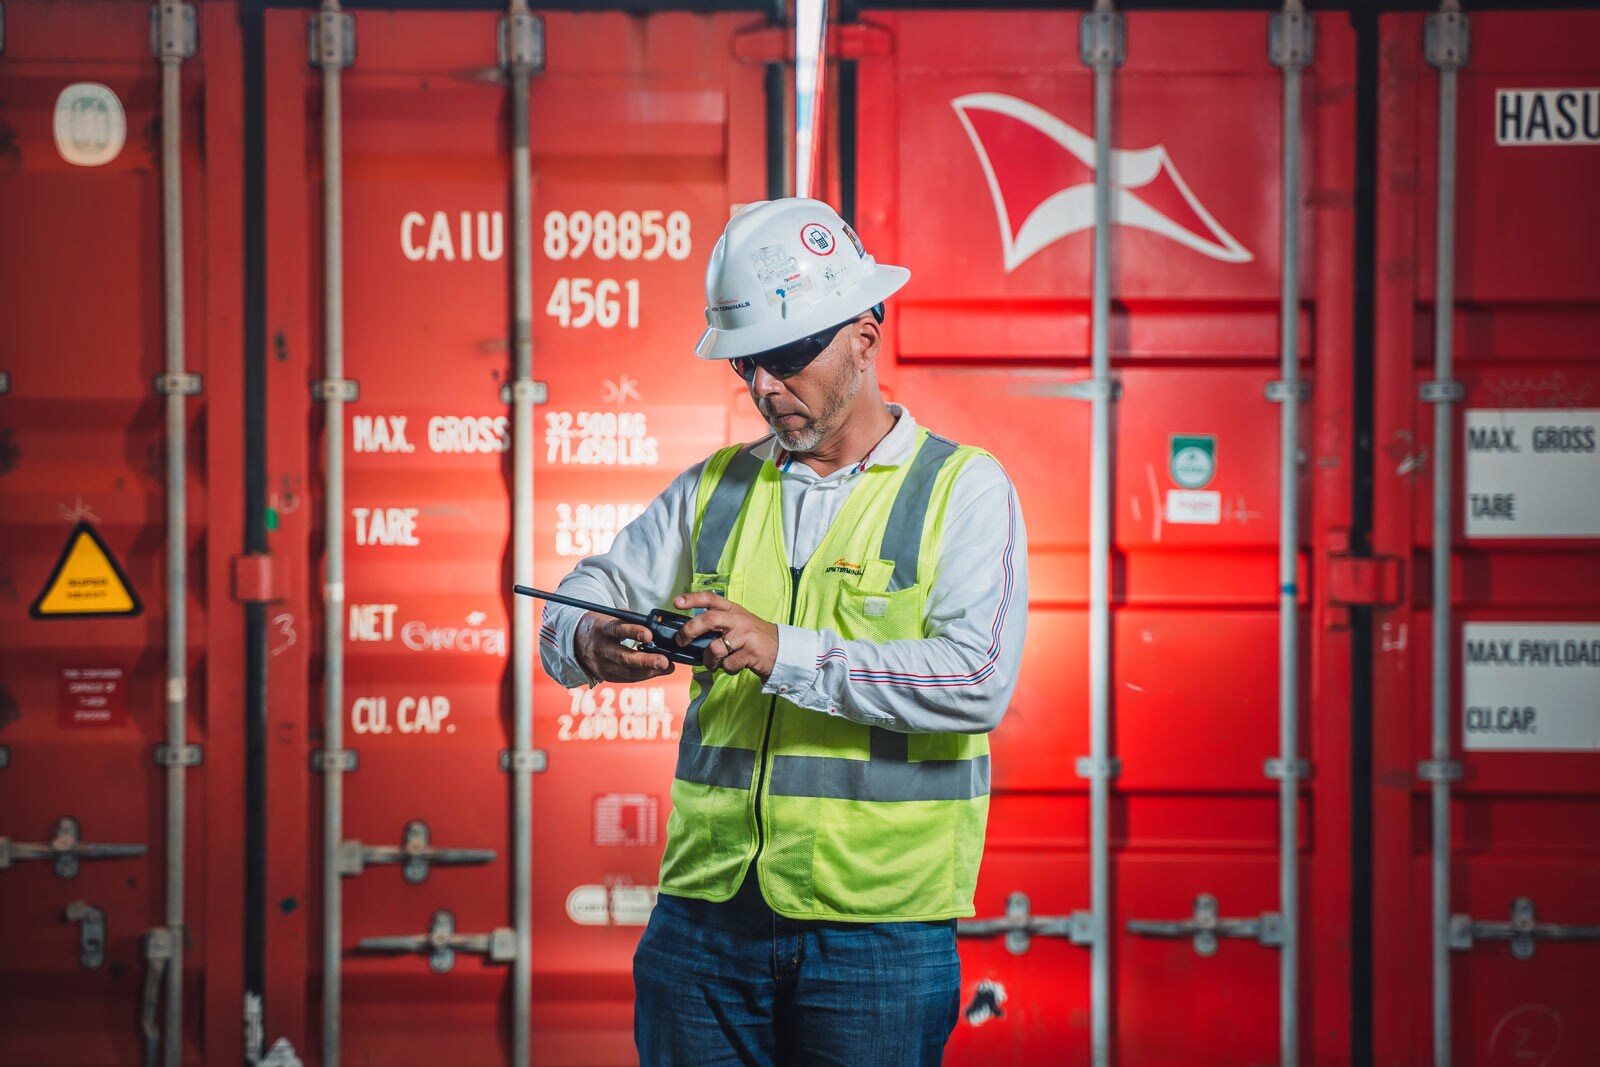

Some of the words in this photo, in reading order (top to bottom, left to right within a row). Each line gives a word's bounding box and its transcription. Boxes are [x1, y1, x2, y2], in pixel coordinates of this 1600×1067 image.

[1499, 92, 1600, 140] HASU
[400, 211, 504, 261] CAIU
[543, 210, 692, 260] 898858
[546, 278, 640, 328] 45G1
[353, 416, 415, 453] MAX.
[428, 416, 510, 453] GROSS
[1467, 426, 1520, 453] MAX.
[1532, 425, 1597, 453] GROSS
[1471, 493, 1517, 521] TARE
[352, 508, 420, 546] TARE
[350, 604, 398, 641] NET
[398, 696, 456, 733] CAP.
